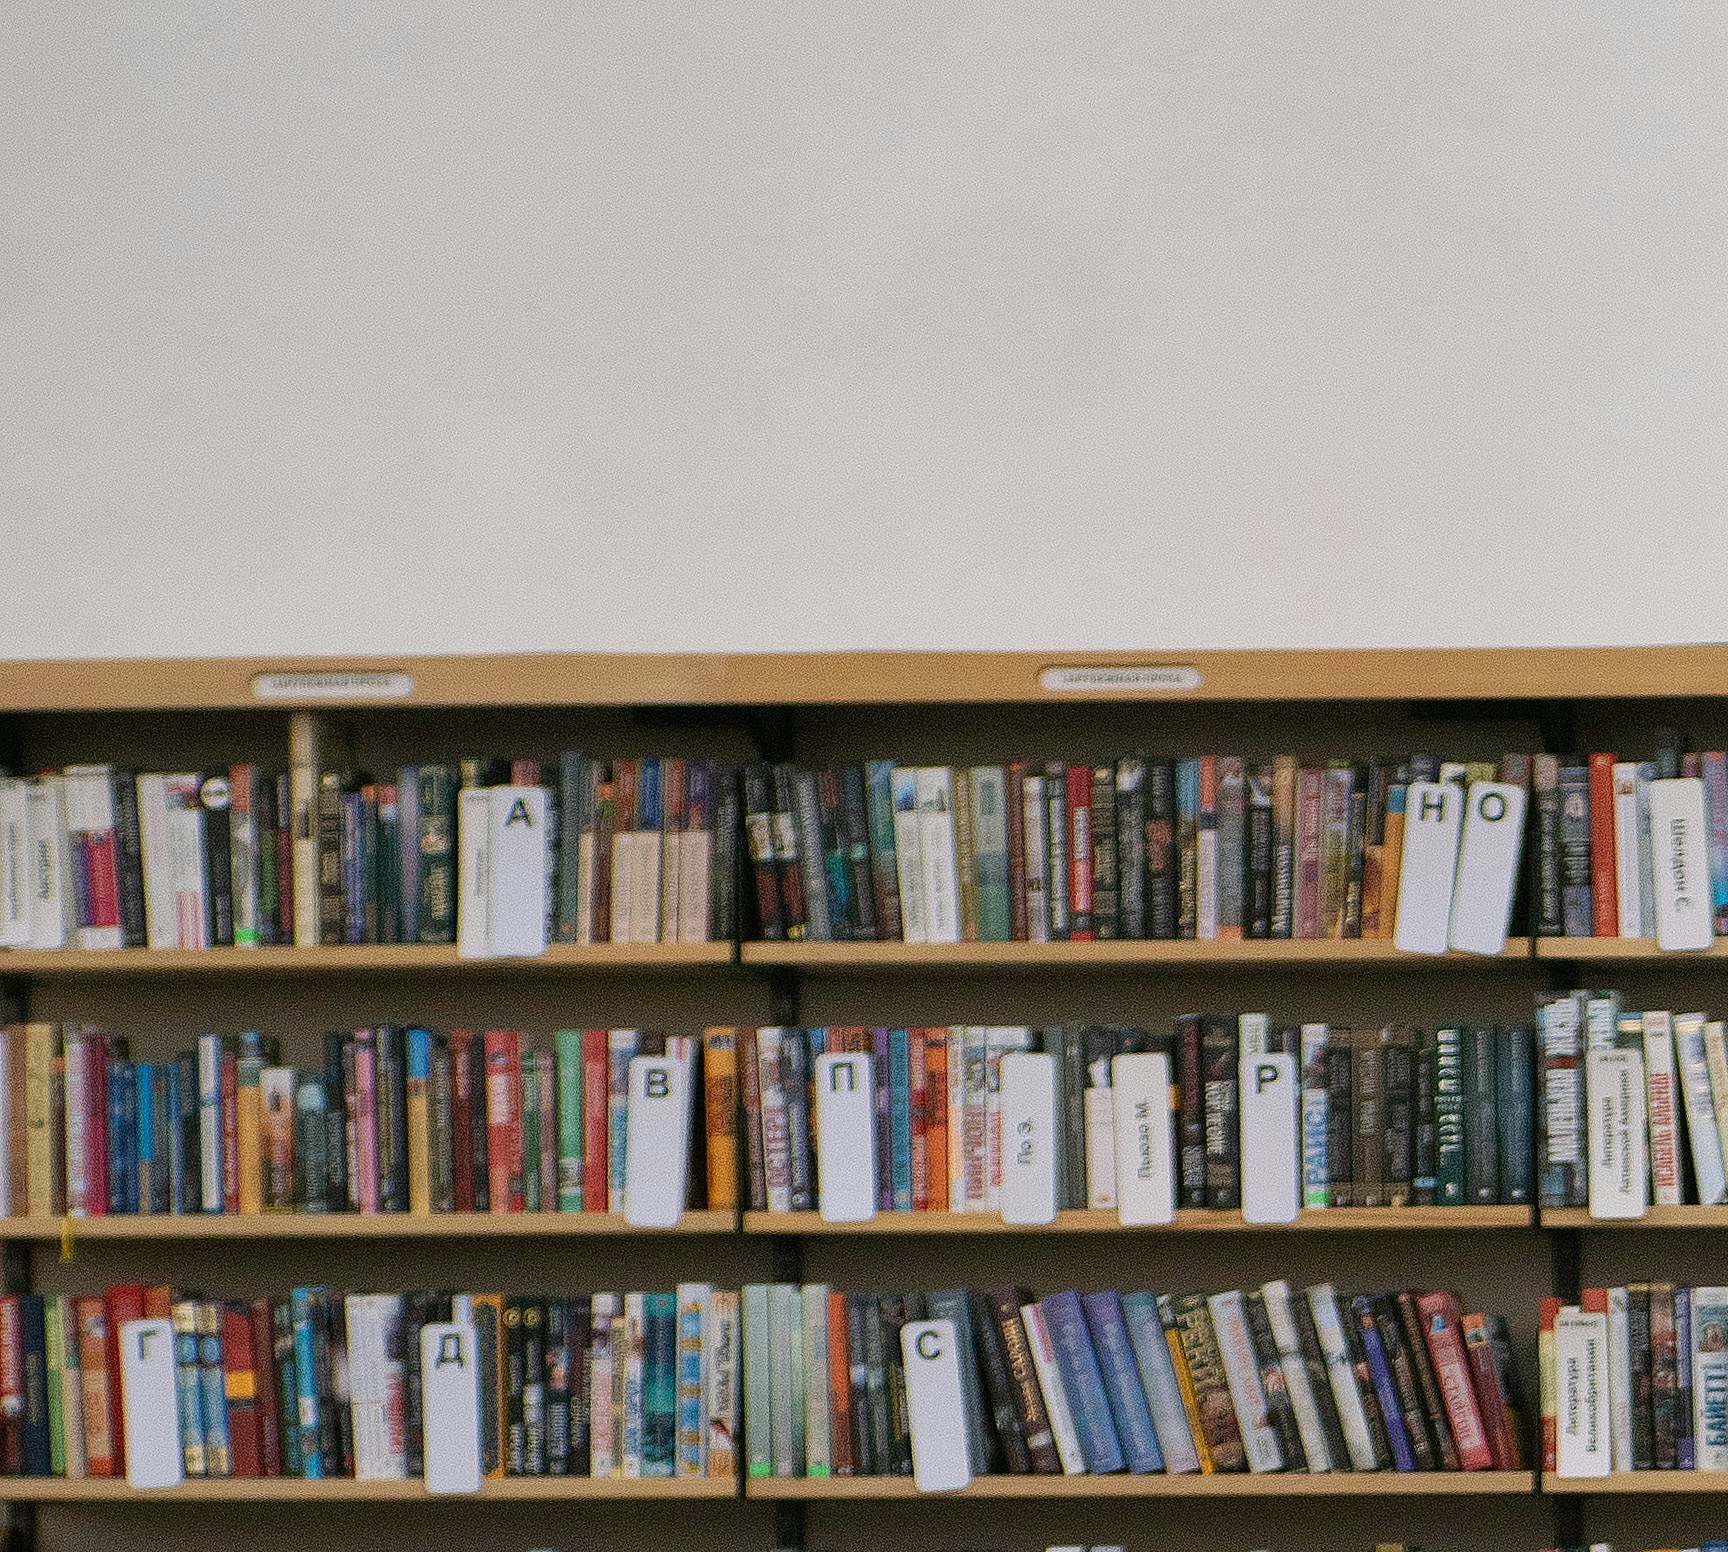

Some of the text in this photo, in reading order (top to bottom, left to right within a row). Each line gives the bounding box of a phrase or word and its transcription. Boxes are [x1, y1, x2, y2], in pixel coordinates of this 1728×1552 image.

[505, 797, 533, 827] А
[1419, 792, 1446, 822] Н
[1477, 791, 1508, 823] О
[1671, 818, 1687, 893] Шелдон
[645, 1067, 671, 1099] В
[830, 1061, 856, 1092] П
[1255, 1063, 1280, 1094] Р
[1542, 998, 1579, 1164] МАЛЕНЬКАЯ ЖИЗНЬ
[1602, 1096, 1615, 1167] Литература
[1619, 1069, 1631, 1193] Латинской Америки
[1017, 1140, 1034, 1165] По
[137, 1328, 158, 1361] Г
[435, 1333, 465, 1368] Д
[915, 1329, 942, 1361] С
[1566, 1356, 1581, 1435] Литература
[1585, 1338, 1599, 1453] Великобритании
[1702, 1372, 1728, 1447] БАЙЕТТ
